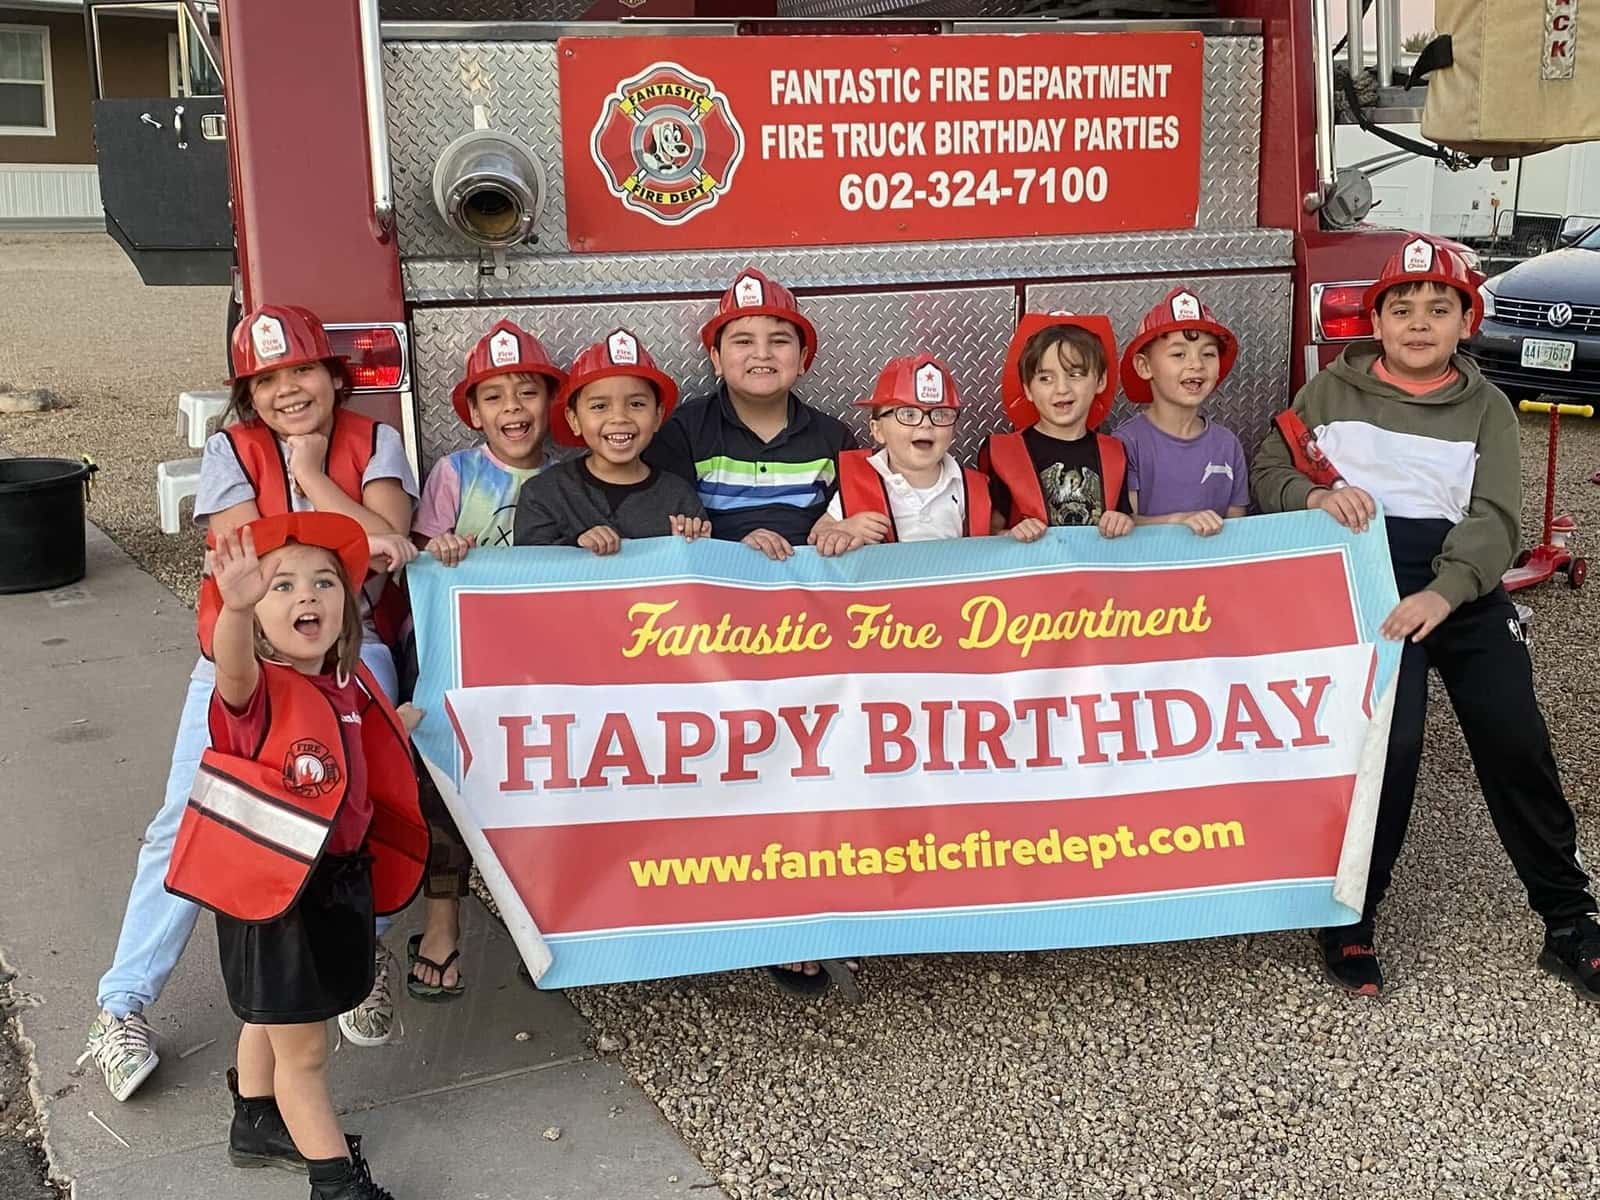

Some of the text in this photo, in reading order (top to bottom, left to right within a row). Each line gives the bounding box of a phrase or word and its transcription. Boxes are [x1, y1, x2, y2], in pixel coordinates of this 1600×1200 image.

[628, 84, 706, 107] FANTASTIC
[770, 64, 1173, 105] FANTASTIC FIRE DEPARTMENT
[761, 115, 1180, 160] FIRE TRUCK BIRTHDAY PARTIES
[631, 183, 706, 203] FIRE DEPT
[838, 165, 1109, 211] 602-324-7100
[621, 595, 1212, 658] Fantastic Fire Department
[296, 743, 321, 754] FIRE
[498, 676, 1333, 794] HAPPY BIRTHDAY
[629, 818, 1246, 888] www.fantasticfiredept.com
